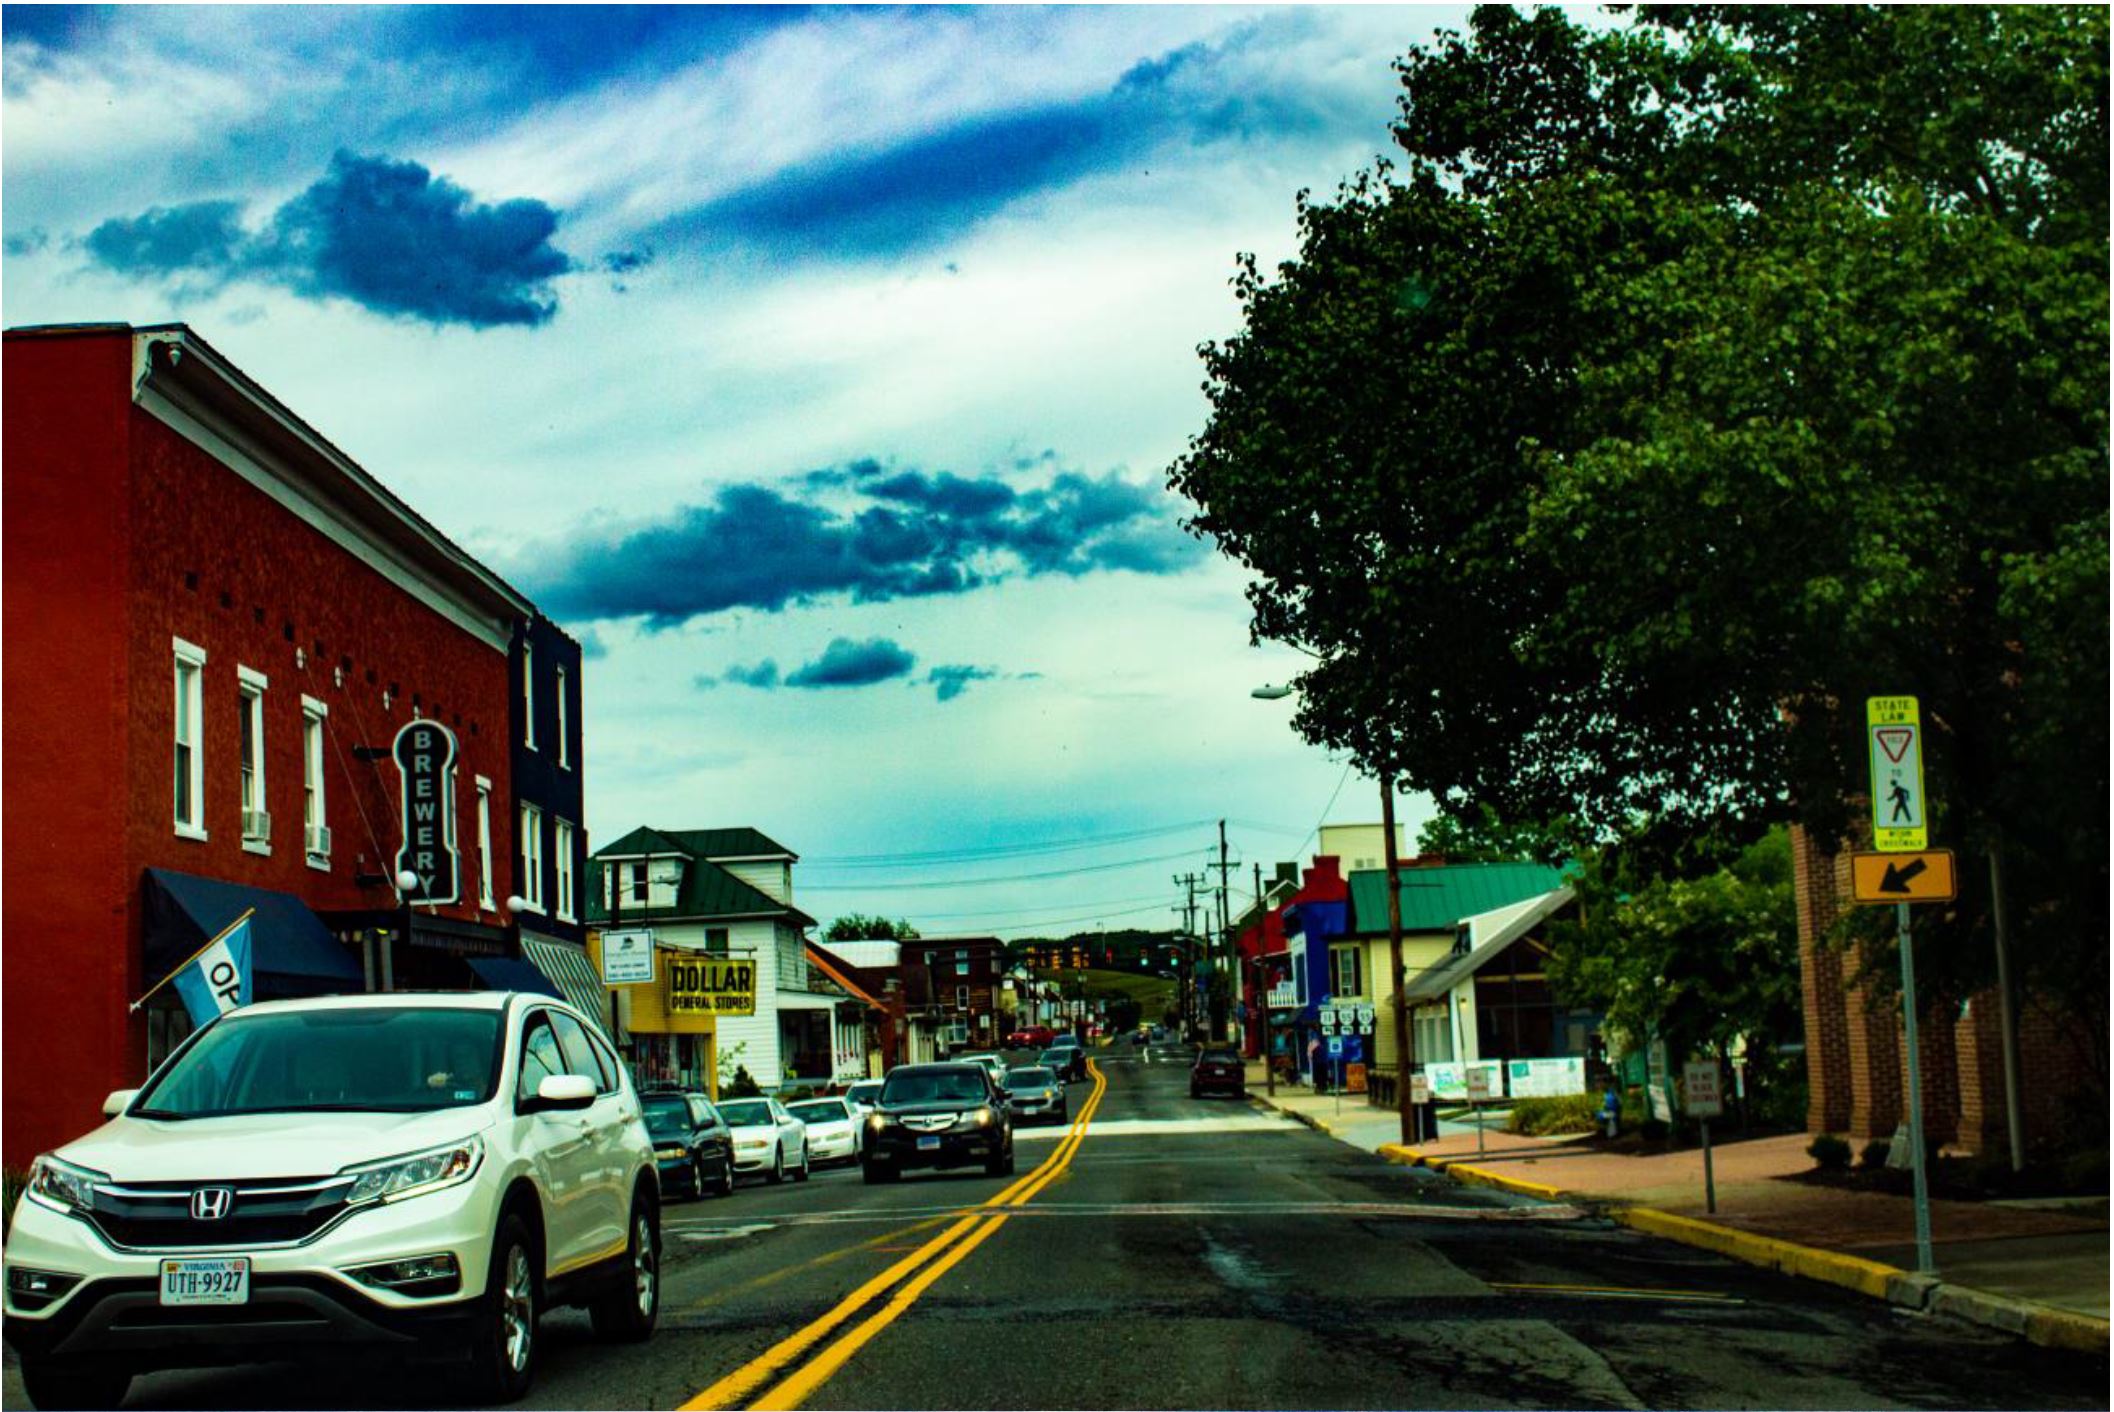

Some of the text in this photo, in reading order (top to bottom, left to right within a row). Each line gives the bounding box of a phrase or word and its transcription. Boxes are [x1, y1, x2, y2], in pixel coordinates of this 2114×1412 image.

[1875, 700, 1909, 710] STATE
[1881, 712, 1905, 722] LAW
[414, 731, 435, 897] BREWERY
[672, 966, 751, 993] DOLLAR
[714, 996, 751, 1009] STORES
[183, 1262, 225, 1271] VIRGINIA
[168, 1271, 243, 1293] UTH-9927
